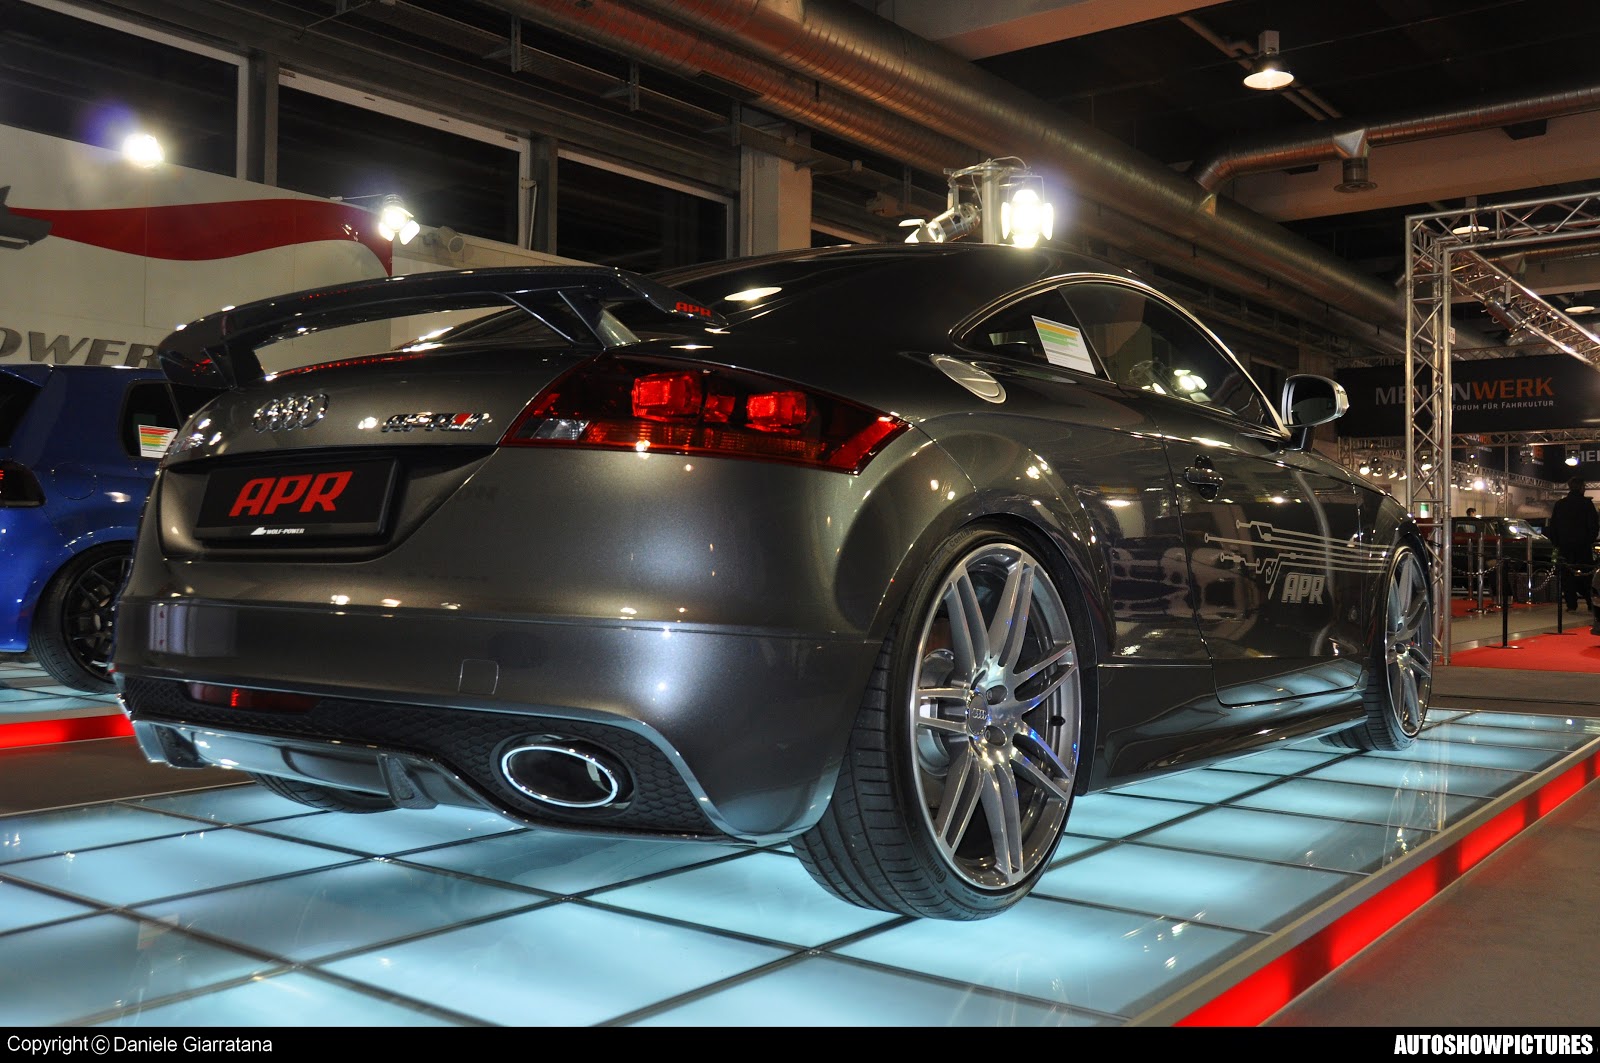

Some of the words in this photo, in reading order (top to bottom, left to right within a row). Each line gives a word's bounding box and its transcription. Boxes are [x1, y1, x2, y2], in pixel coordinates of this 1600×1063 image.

[675, 301, 712, 317] APR
[1375, 377, 1555, 406] MEILNWERK
[1501, 400, 1555, 409] FAHRKULTUR
[228, 471, 353, 517] APR
[1281, 572, 1326, 604] APR
